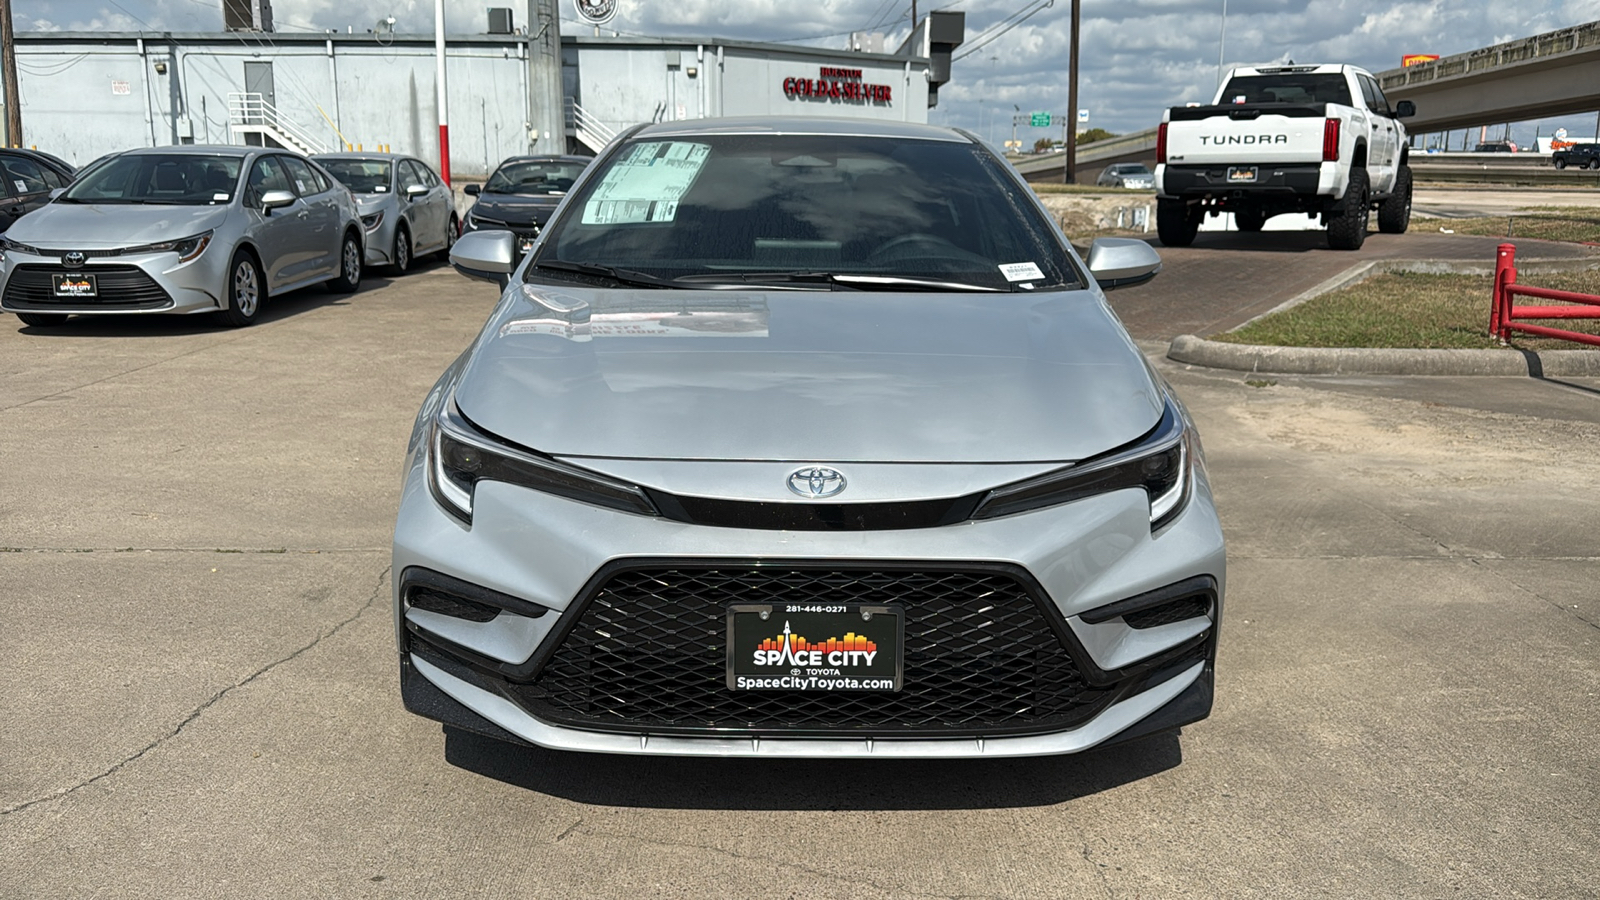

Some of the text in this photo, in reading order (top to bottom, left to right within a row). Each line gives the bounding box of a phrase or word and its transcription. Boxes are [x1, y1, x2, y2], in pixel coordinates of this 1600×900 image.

[820, 66, 863, 78] HOUSTON
[1199, 134, 1287, 146] TUNDRA
[785, 605, 847, 613] 281-446-0271
[753, 650, 877, 666] SPACE CITY
[806, 668, 841, 676] TOYOTA
[737, 676, 893, 690] SpaceCityToyota.com
